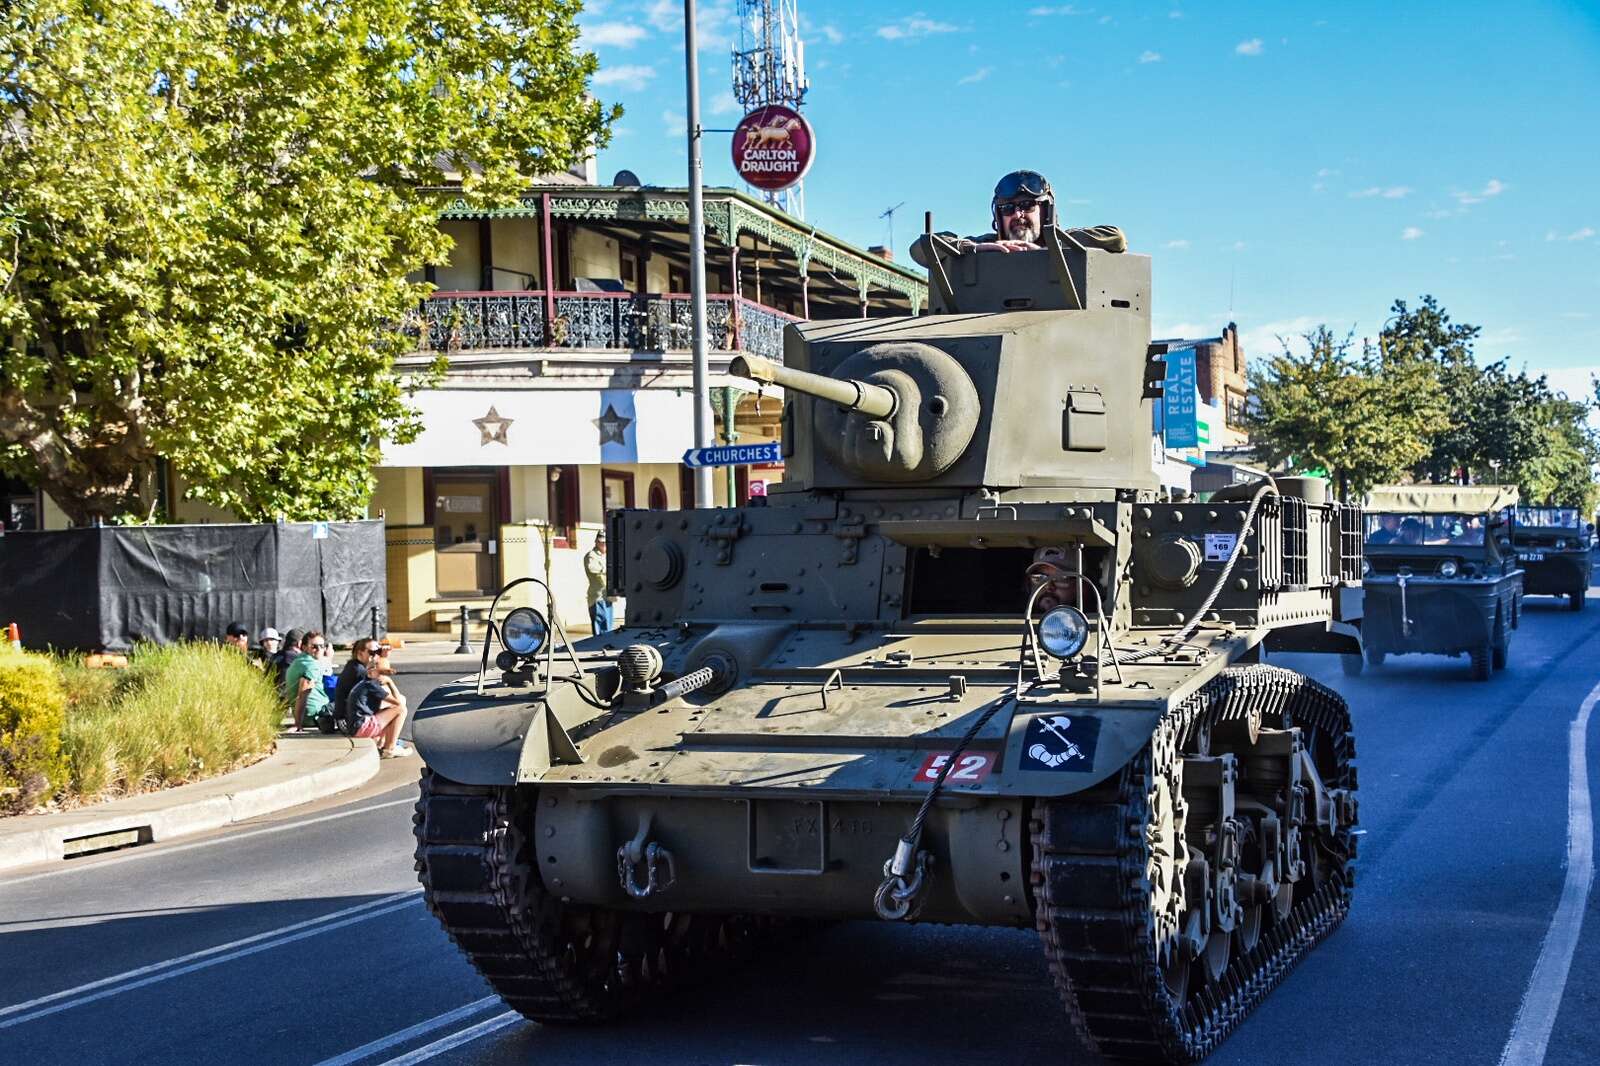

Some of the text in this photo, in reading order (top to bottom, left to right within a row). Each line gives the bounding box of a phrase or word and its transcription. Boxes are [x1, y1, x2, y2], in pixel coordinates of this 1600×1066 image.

[744, 149, 796, 160] CARLTON
[741, 161, 799, 172] DRAUGHT
[1181, 356, 1194, 414] ESTATE
[1168, 374, 1180, 415] REAL
[705, 447, 771, 463] CHURCHES
[1213, 543, 1229, 551] 169
[925, 755, 987, 779] 52
